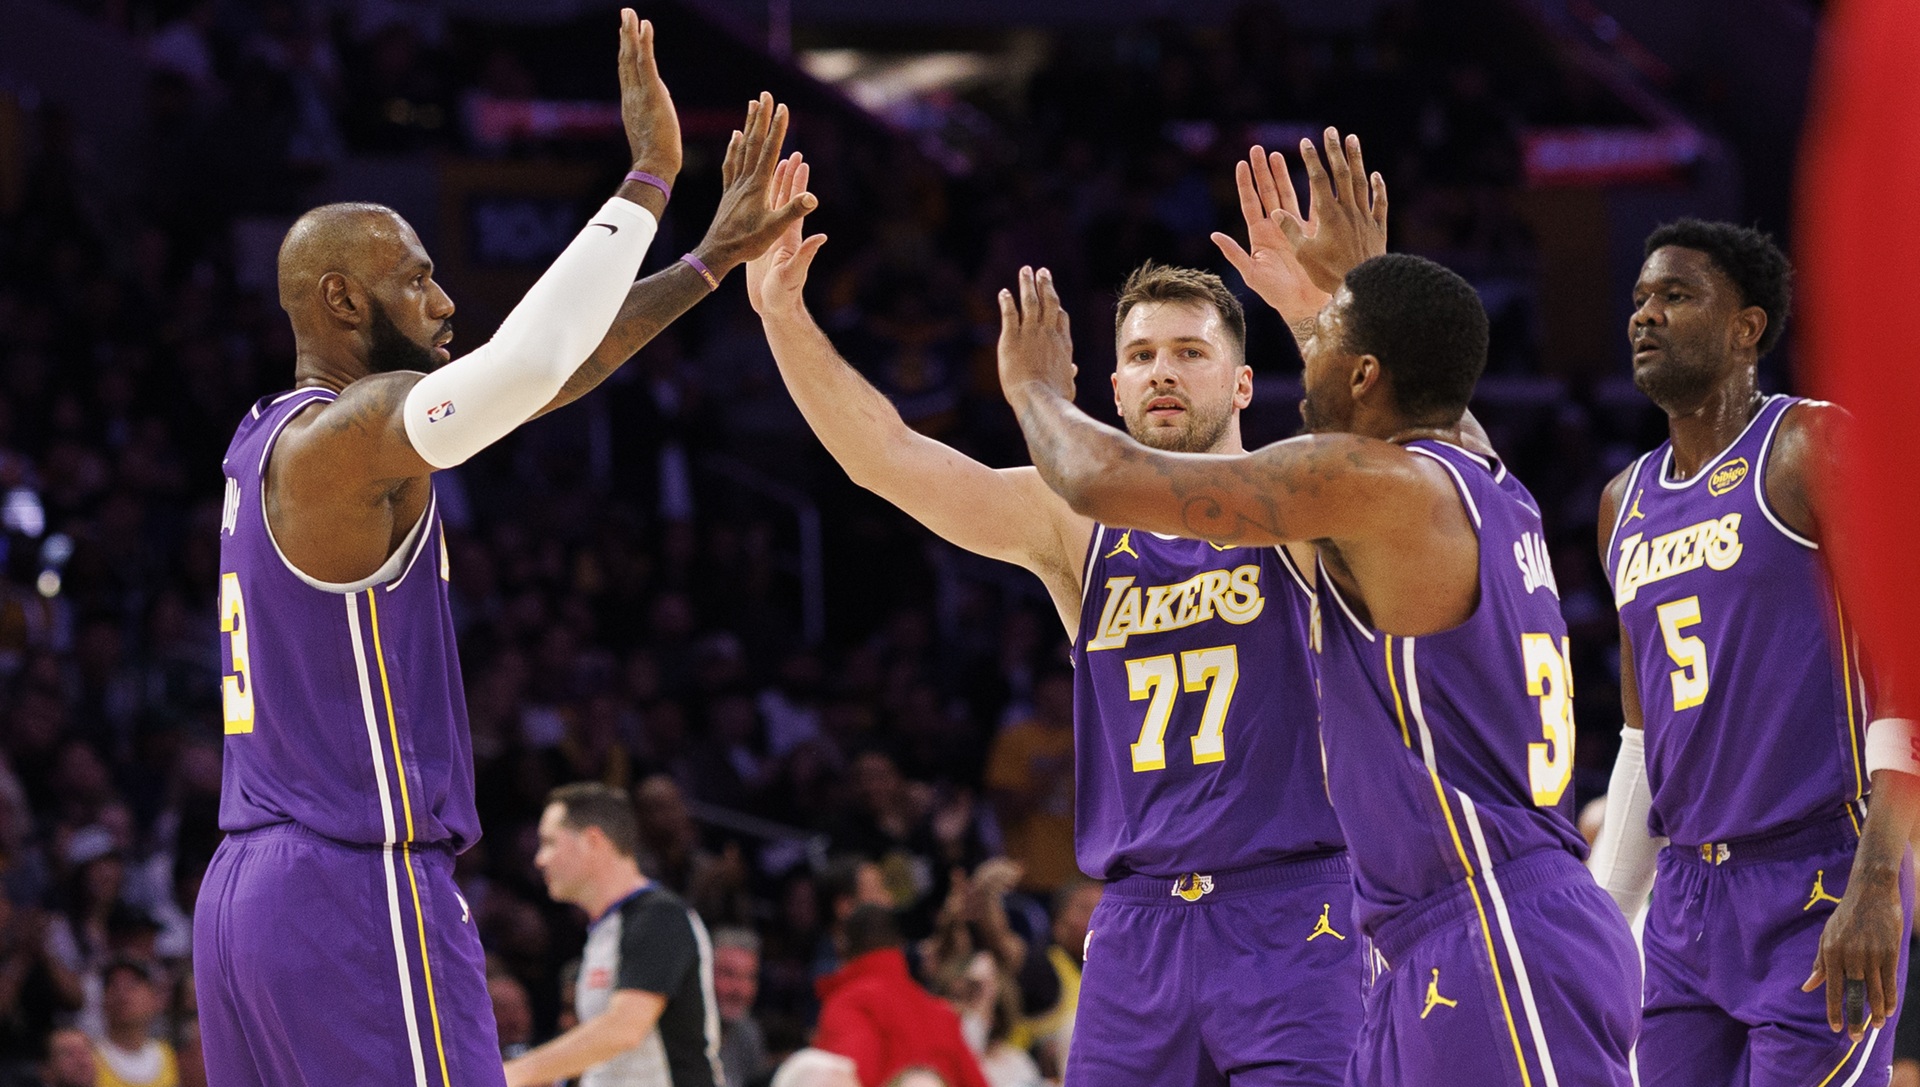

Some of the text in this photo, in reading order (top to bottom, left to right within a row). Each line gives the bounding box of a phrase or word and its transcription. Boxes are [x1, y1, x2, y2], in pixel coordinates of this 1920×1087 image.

[1086, 564, 1265, 652] LAKERS
[1615, 512, 1743, 612] LAKERS
[1656, 595, 1709, 712] 5
[1125, 644, 1239, 772] 77
